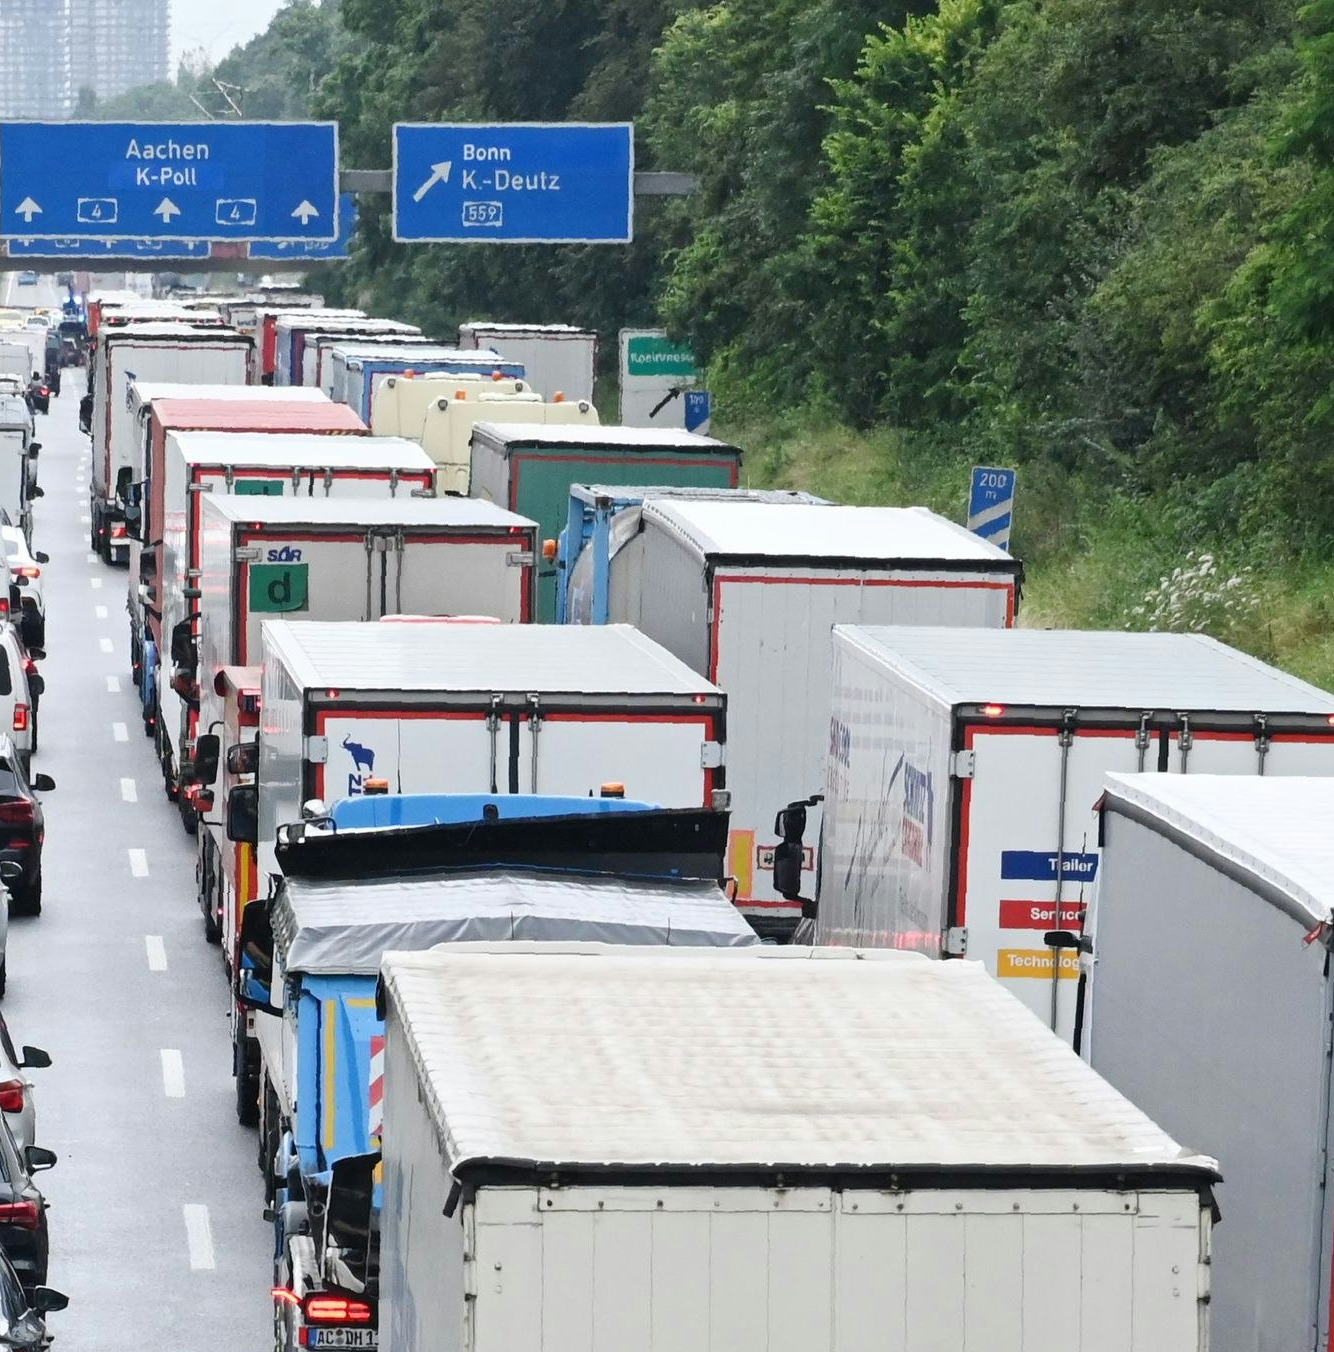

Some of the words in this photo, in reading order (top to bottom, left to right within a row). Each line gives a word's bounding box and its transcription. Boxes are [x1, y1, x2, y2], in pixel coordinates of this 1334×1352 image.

[125, 138, 210, 160] Aachen
[463, 143, 511, 161] Bonn
[136, 167, 197, 186] K-Poll
[462, 169, 560, 191] K.-Deutz
[91, 203, 102, 220] 4
[230, 204, 241, 221] 4
[468, 205, 496, 221] 559
[979, 472, 1008, 488] 200
[268, 571, 291, 604] d
[1048, 858, 1094, 872] Tailer
[317, 1330, 334, 1345] AC
[345, 1330, 363, 1346] DH
